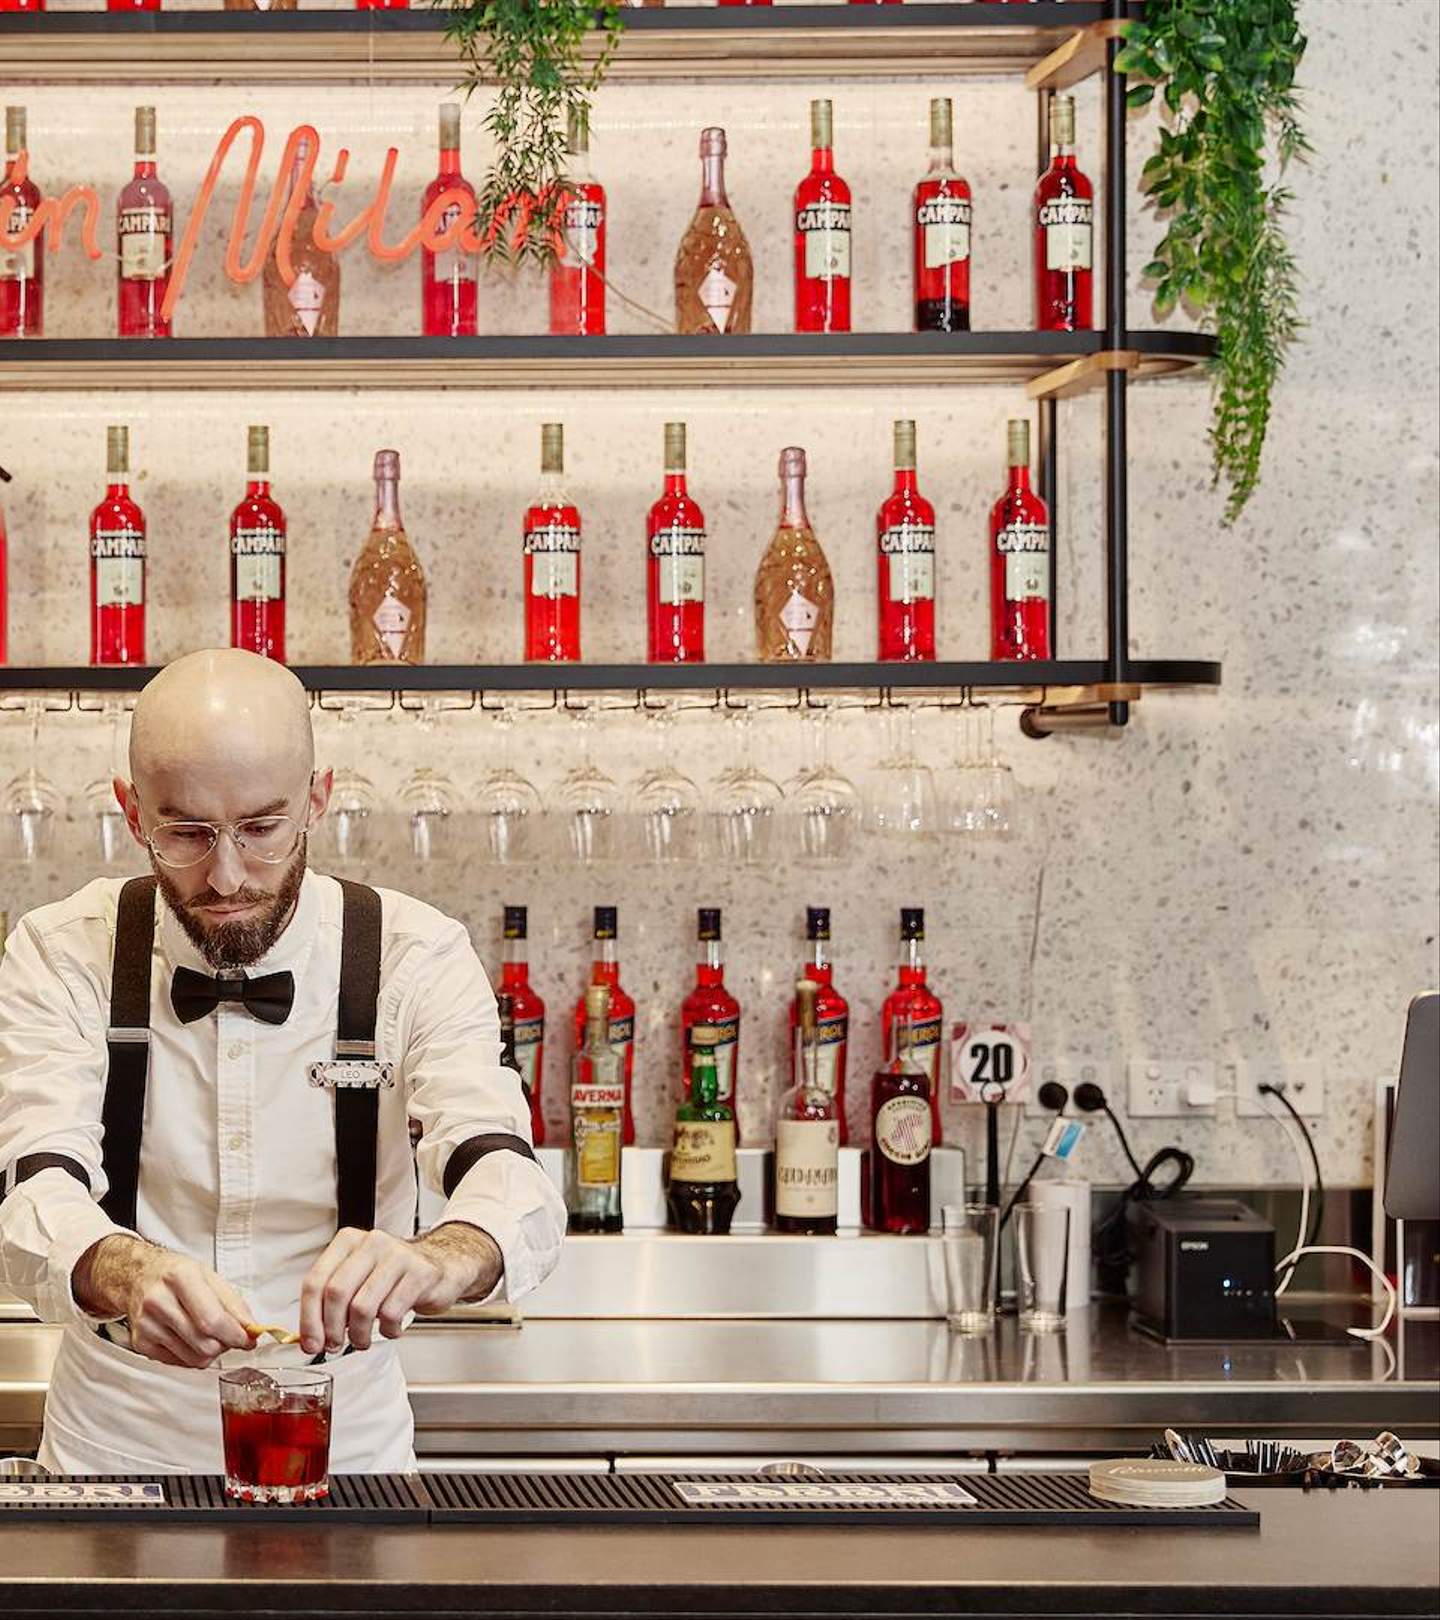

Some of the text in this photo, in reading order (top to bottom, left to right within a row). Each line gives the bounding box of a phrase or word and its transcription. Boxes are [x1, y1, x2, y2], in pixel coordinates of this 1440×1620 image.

[970, 1042, 1014, 1082] 20
[340, 1069, 361, 1079] LEO
[575, 1088, 622, 1102] AVERNA
